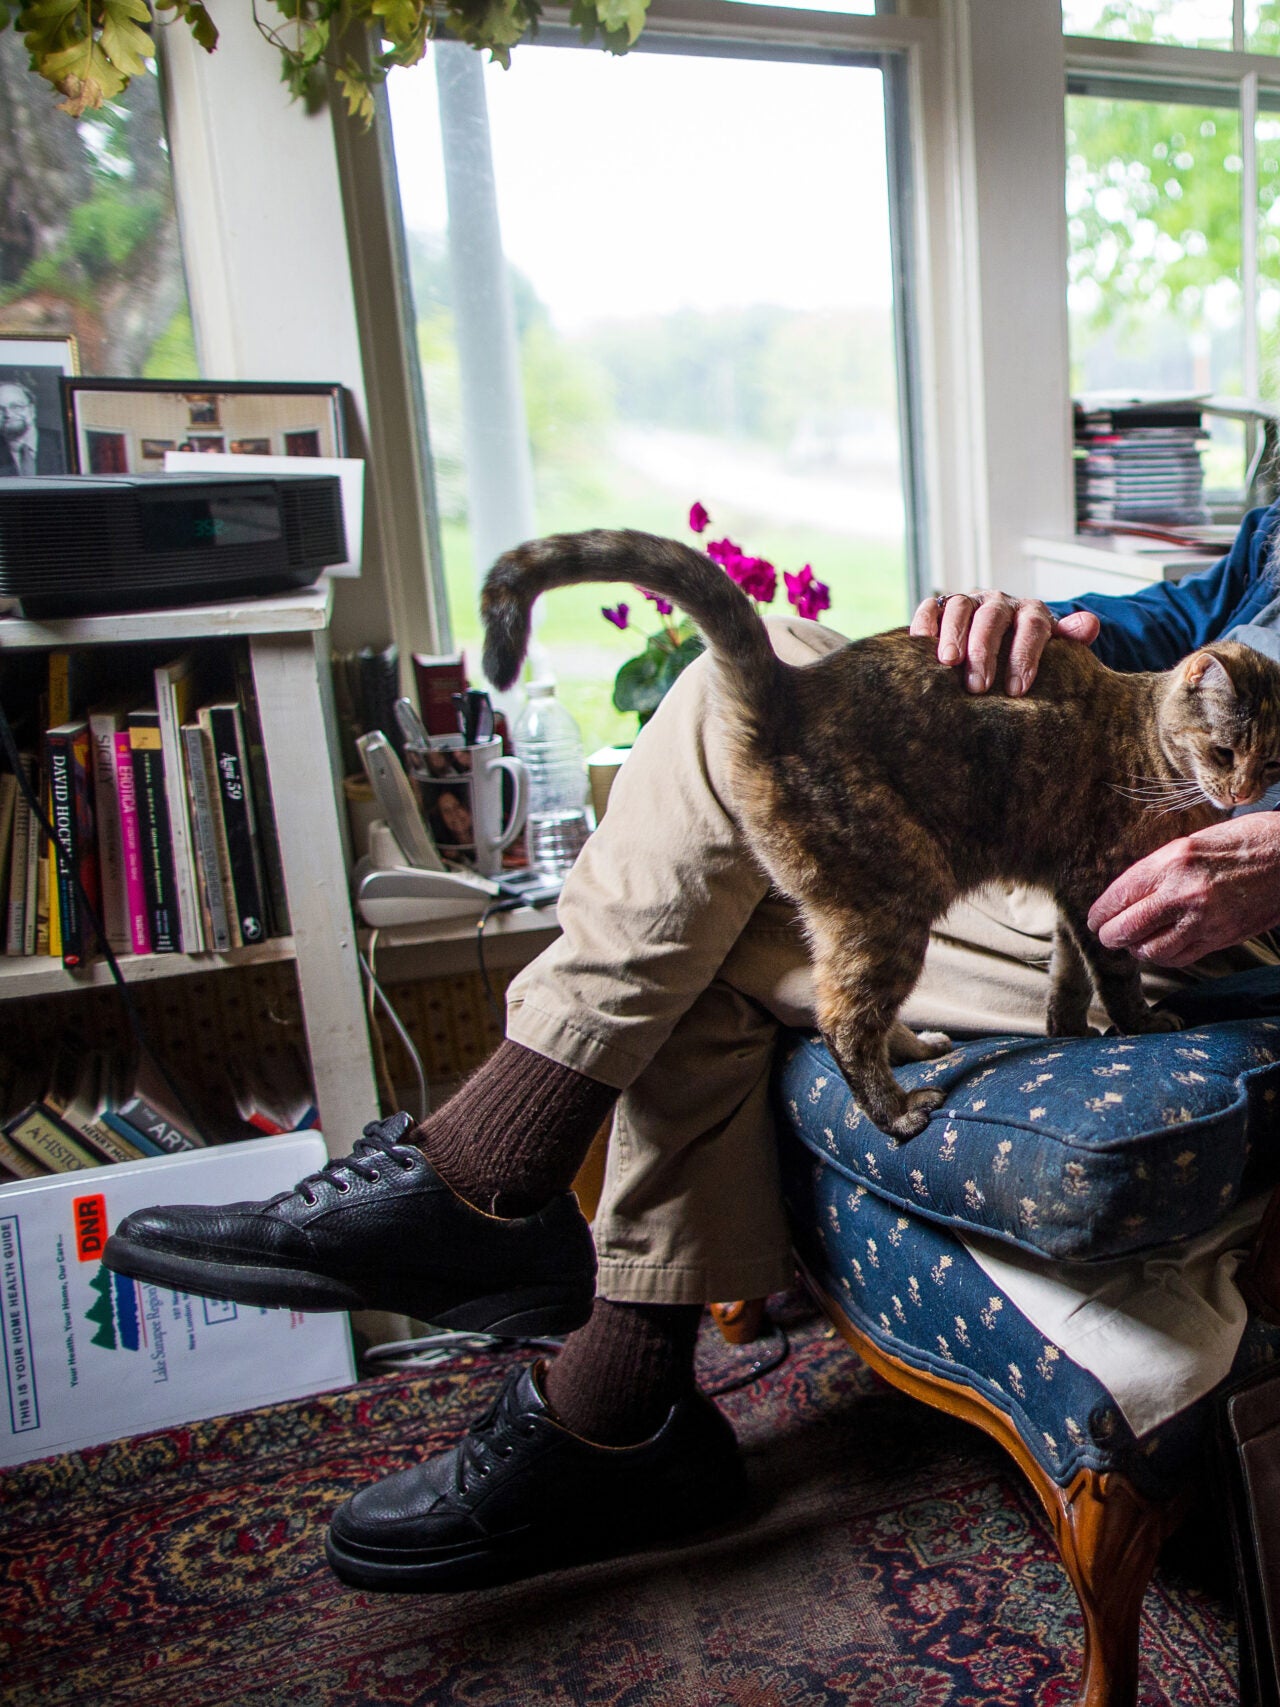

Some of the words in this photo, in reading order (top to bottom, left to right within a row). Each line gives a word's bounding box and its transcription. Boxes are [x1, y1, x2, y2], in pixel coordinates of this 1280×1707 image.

[94, 733, 114, 786] SICILY
[50, 754, 69, 802] DAVID
[222, 779, 244, 803] 59
[53, 804, 75, 875] HOCK
[116, 764, 135, 812] EROTICA
[134, 914, 146, 944] TASCHEN
[24, 1121, 43, 1141] A
[36, 1130, 85, 1175] HISTO
[79, 1122, 112, 1150] HENRY
[145, 1115, 196, 1159] ART
[0, 1222, 13, 1256] GUIDE
[75, 1199, 102, 1253] DNR
[4, 1259, 18, 1307] HEALTH
[57, 1263, 66, 1279] Our
[58, 1281, 71, 1310] Home,
[141, 1286, 164, 1320] Region
[9, 1310, 22, 1344] HOME
[62, 1311, 72, 1331] Your
[182, 1300, 195, 1332] London,
[64, 1332, 77, 1365] Health,
[145, 1319, 170, 1360] Sunapee
[186, 1333, 197, 1350] New
[13, 1347, 25, 1379] YOUR
[68, 1366, 79, 1387] Your
[151, 1360, 169, 1383] Lake
[17, 1383, 27, 1394] IS
[19, 1399, 31, 1425] THIS
